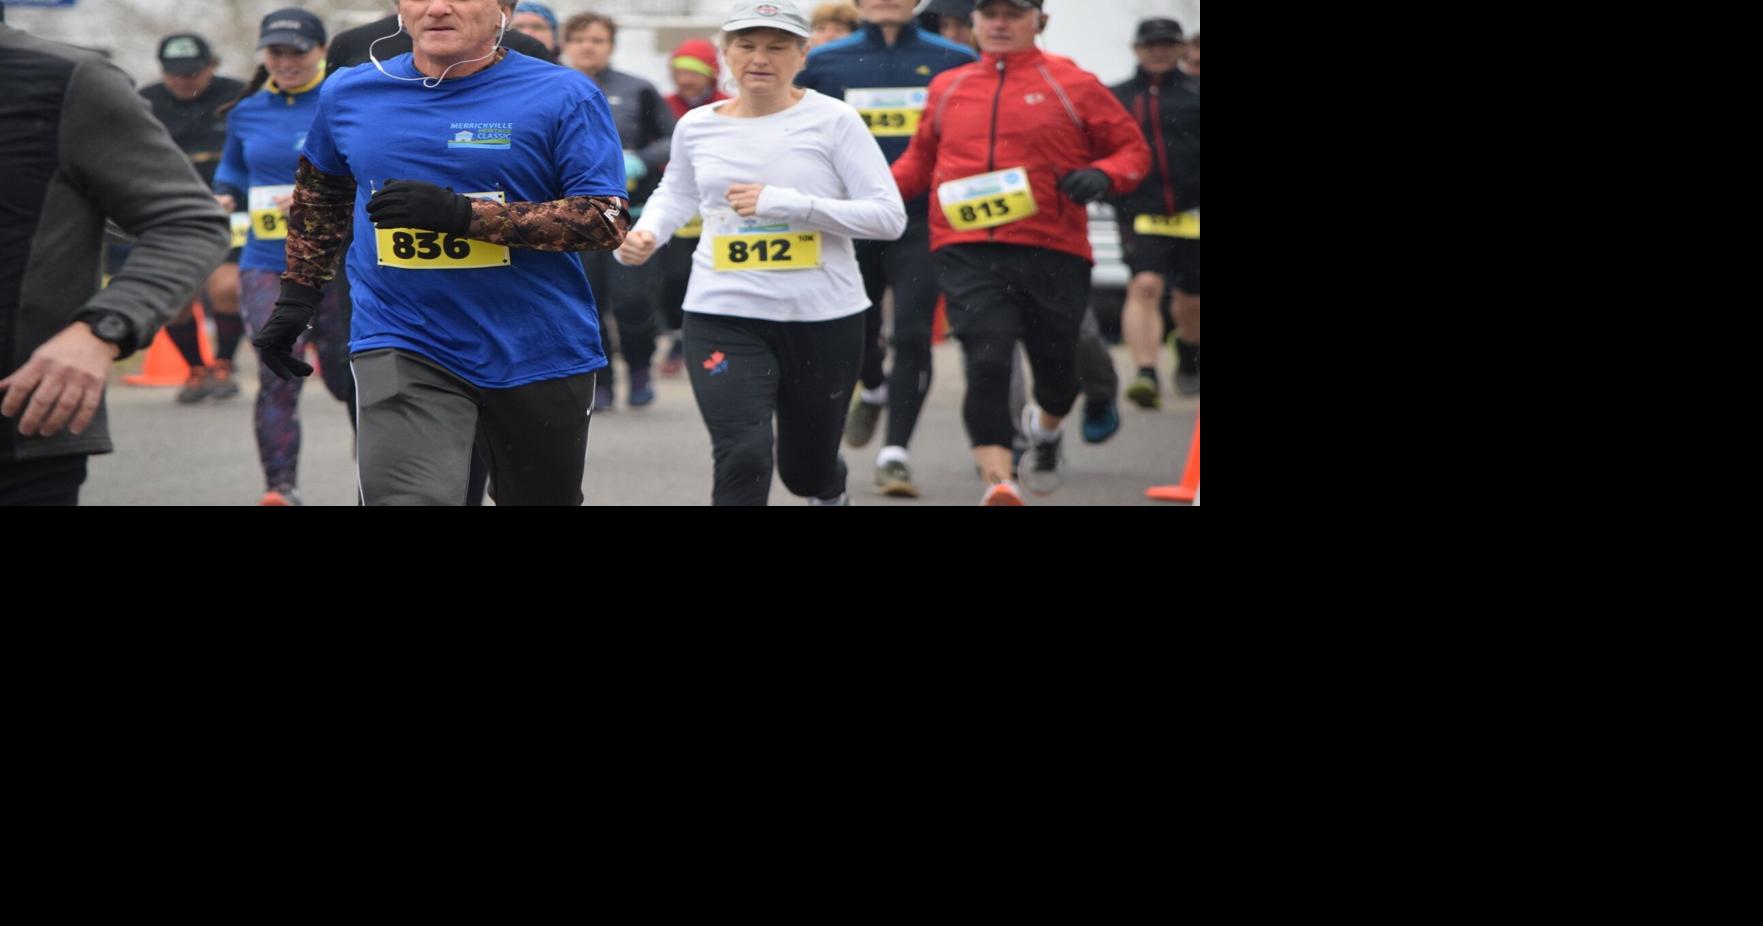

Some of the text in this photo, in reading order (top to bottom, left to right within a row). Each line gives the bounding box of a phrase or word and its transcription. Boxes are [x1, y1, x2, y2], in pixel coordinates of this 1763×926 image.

[959, 198, 1010, 223] 813
[392, 231, 471, 260] 836
[728, 238, 792, 263] 812
